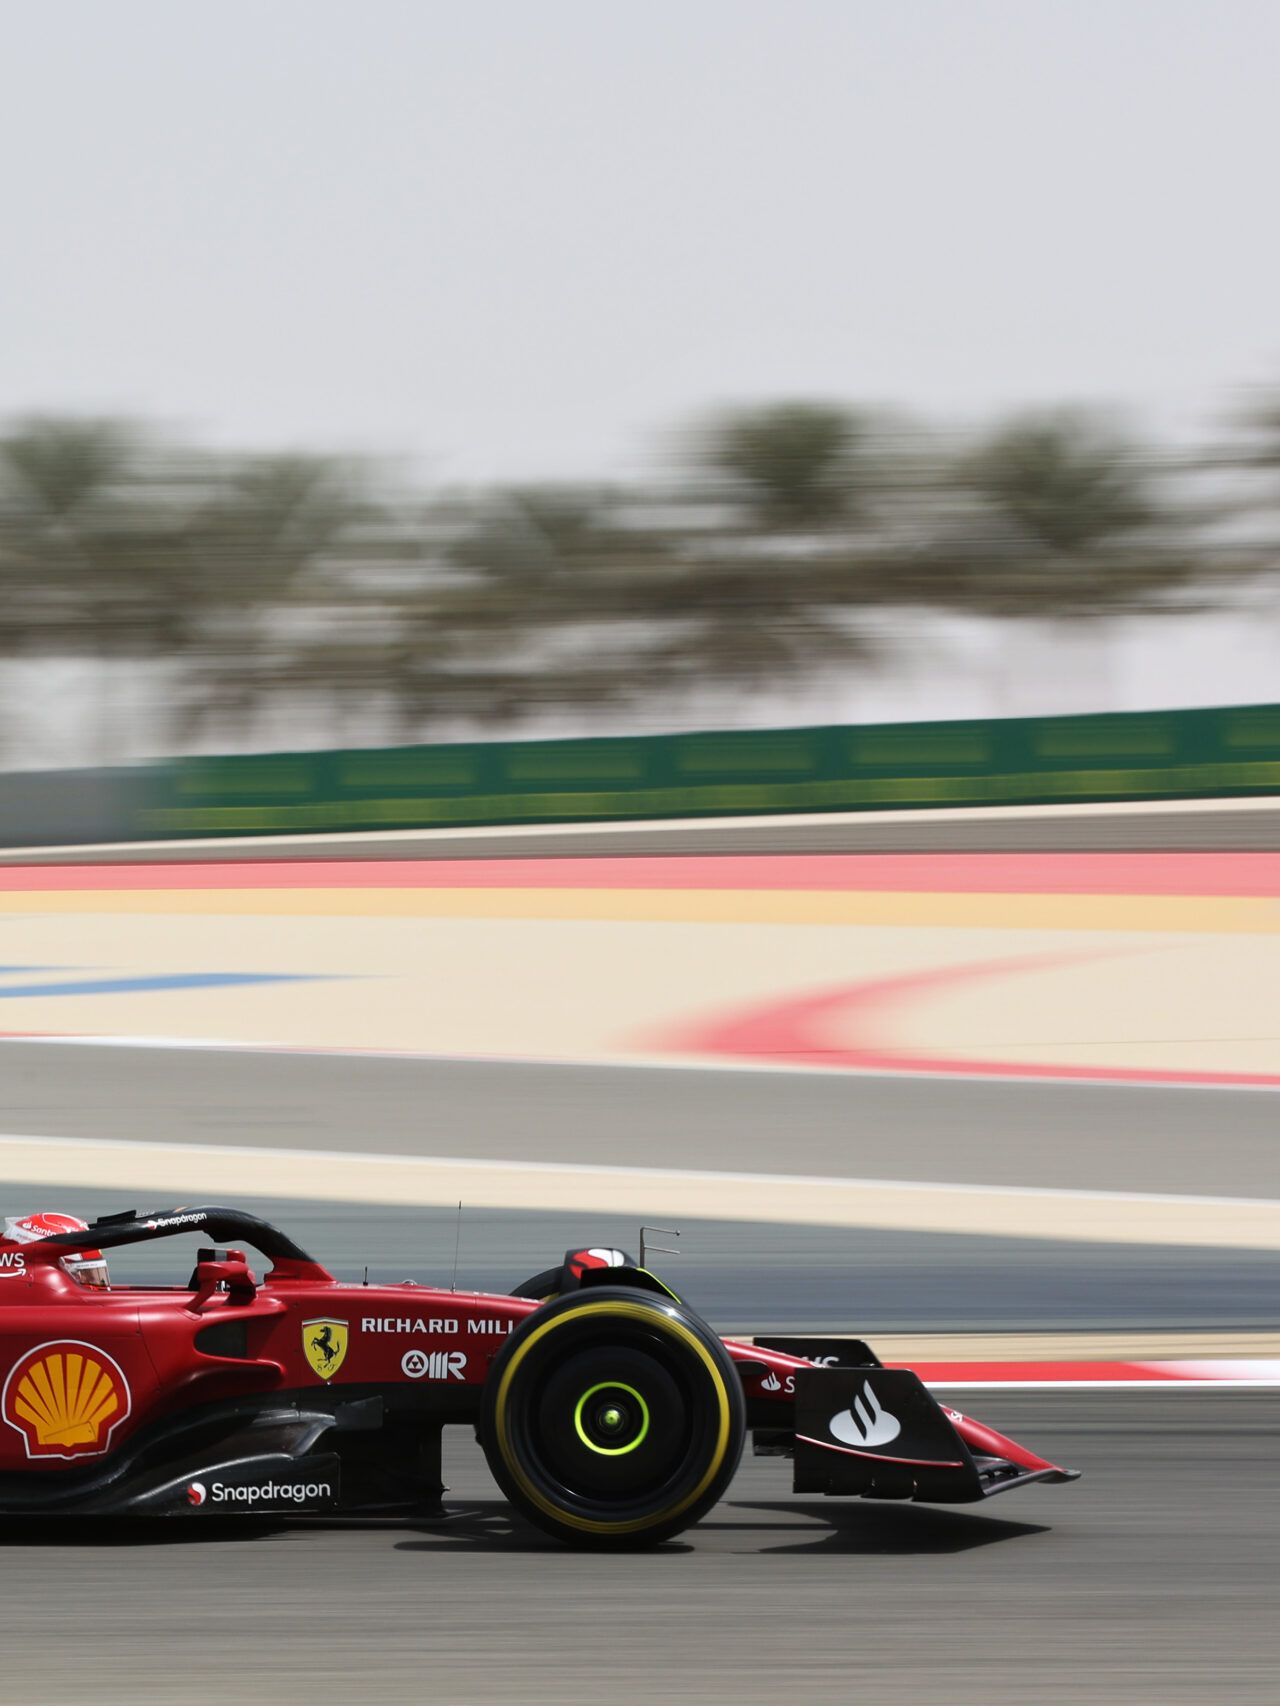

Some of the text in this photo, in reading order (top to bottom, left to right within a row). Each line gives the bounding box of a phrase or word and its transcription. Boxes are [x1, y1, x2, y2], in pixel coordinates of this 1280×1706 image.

[158, 1212, 207, 1227] Snapdragon
[361, 1317, 459, 1334] RICHARD
[211, 1480, 331, 1504] Snapdragon
